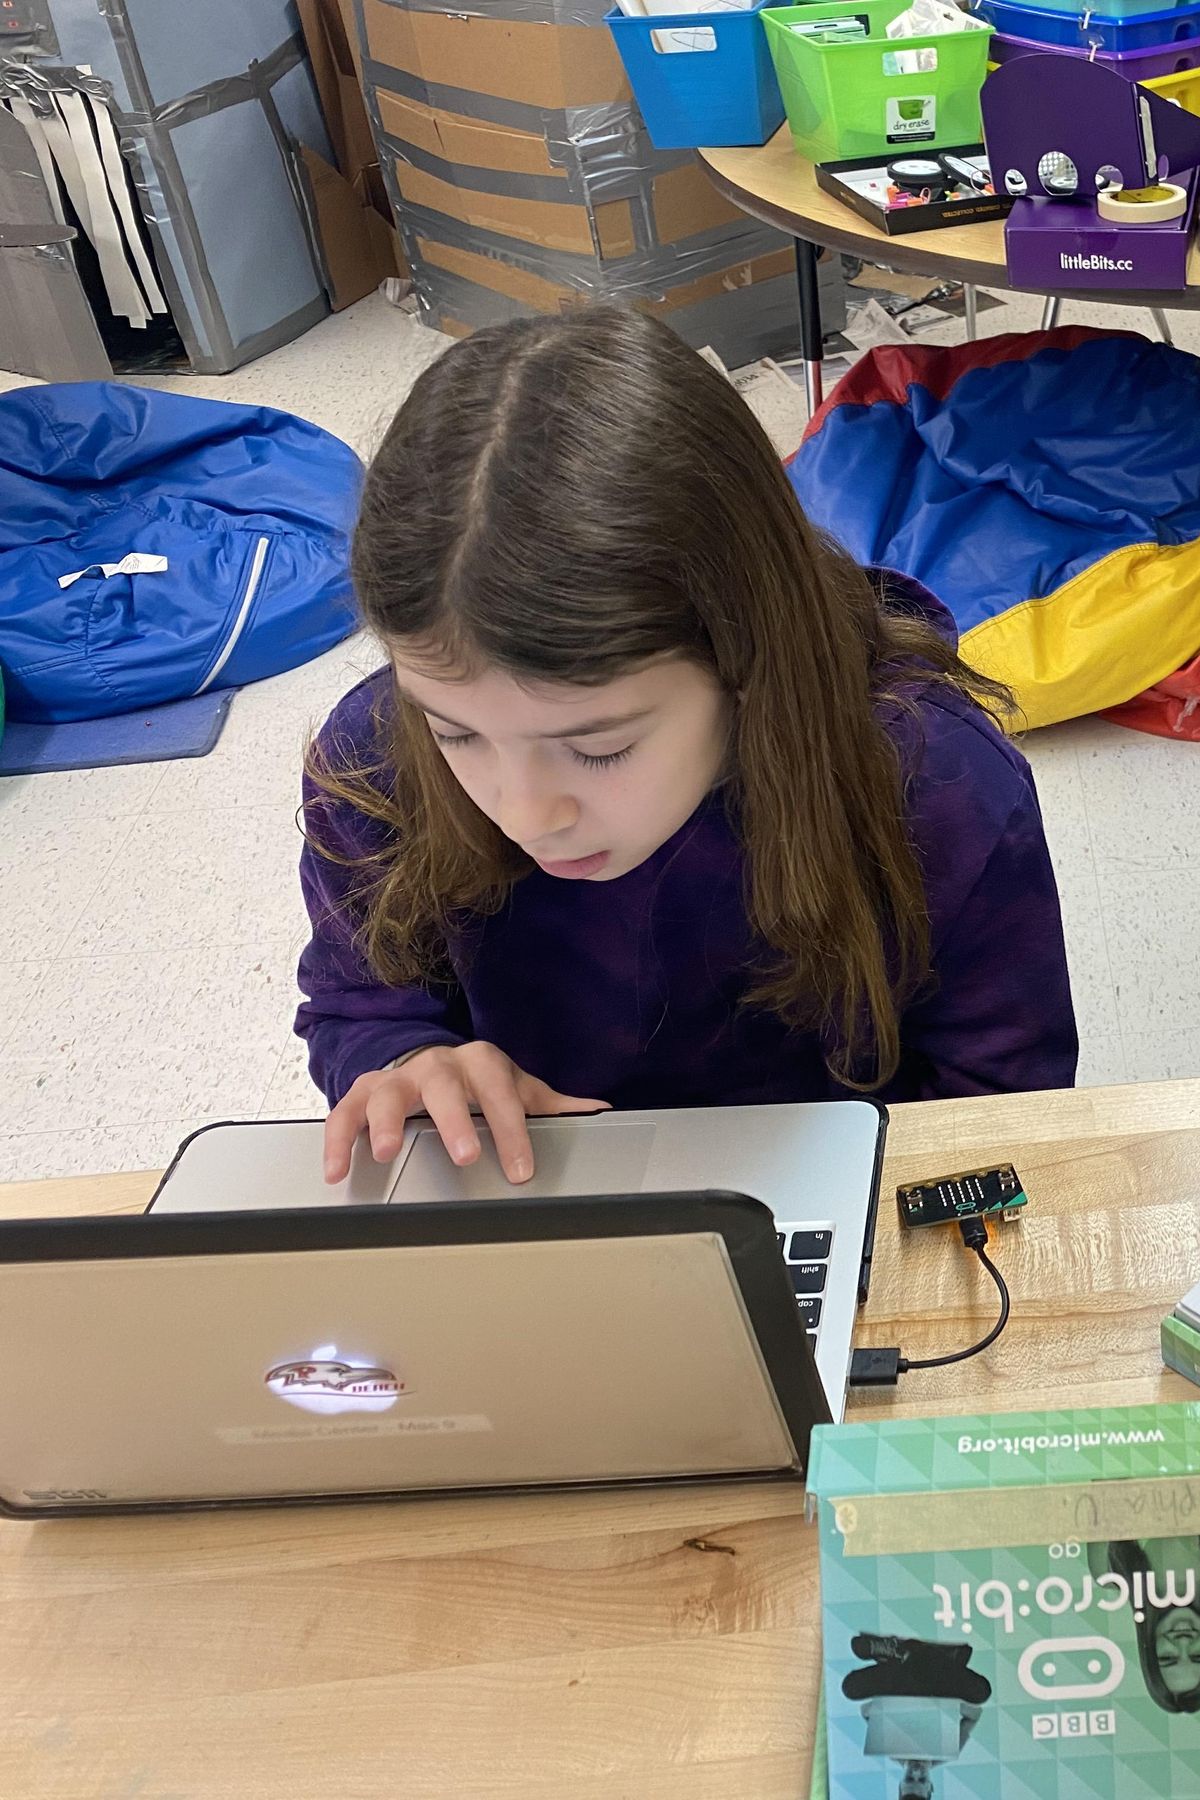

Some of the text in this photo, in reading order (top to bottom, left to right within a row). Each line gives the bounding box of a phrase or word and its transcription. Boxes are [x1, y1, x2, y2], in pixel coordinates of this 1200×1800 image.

[908, 119, 930, 128] erase
[1060, 252, 1133, 270] littleBits.cc
[957, 1428, 1165, 1455] www.microbit.org
[1048, 1534, 1082, 1559] go
[933, 1568, 1196, 1633] micro:bit
[1034, 1711, 1113, 1738] BBC
